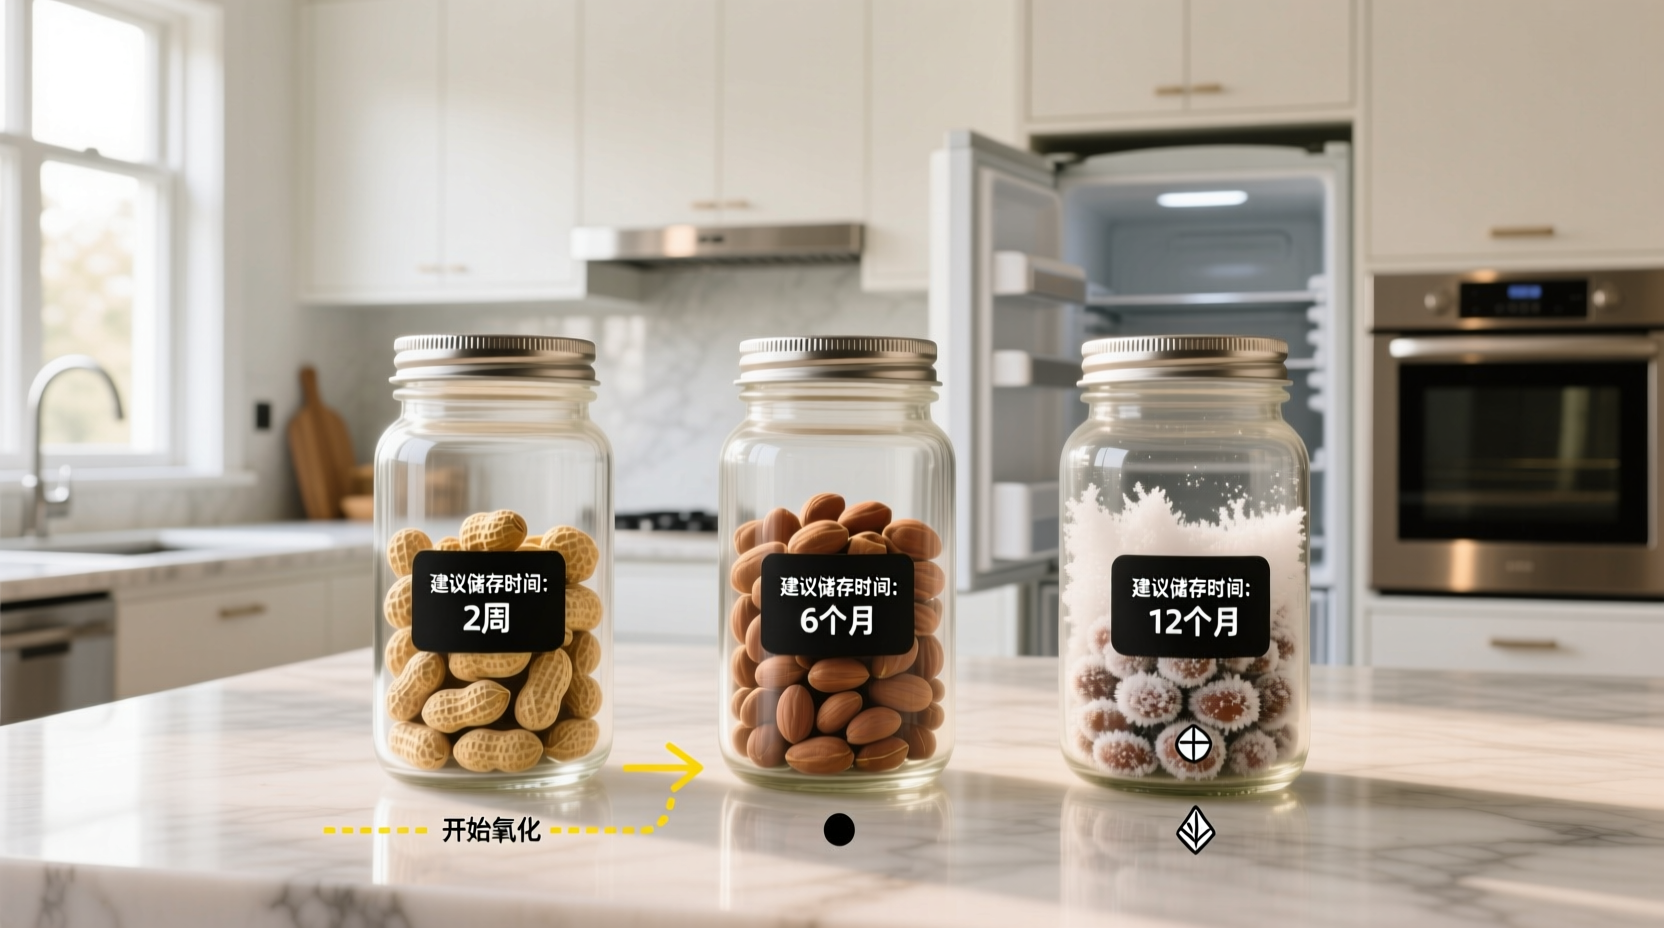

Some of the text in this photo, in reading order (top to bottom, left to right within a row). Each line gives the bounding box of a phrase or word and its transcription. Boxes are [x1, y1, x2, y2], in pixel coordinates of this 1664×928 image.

[463, 602, 510, 635] 2周
[800, 604, 873, 636] 6个月
[1149, 605, 1238, 638] 12个月
